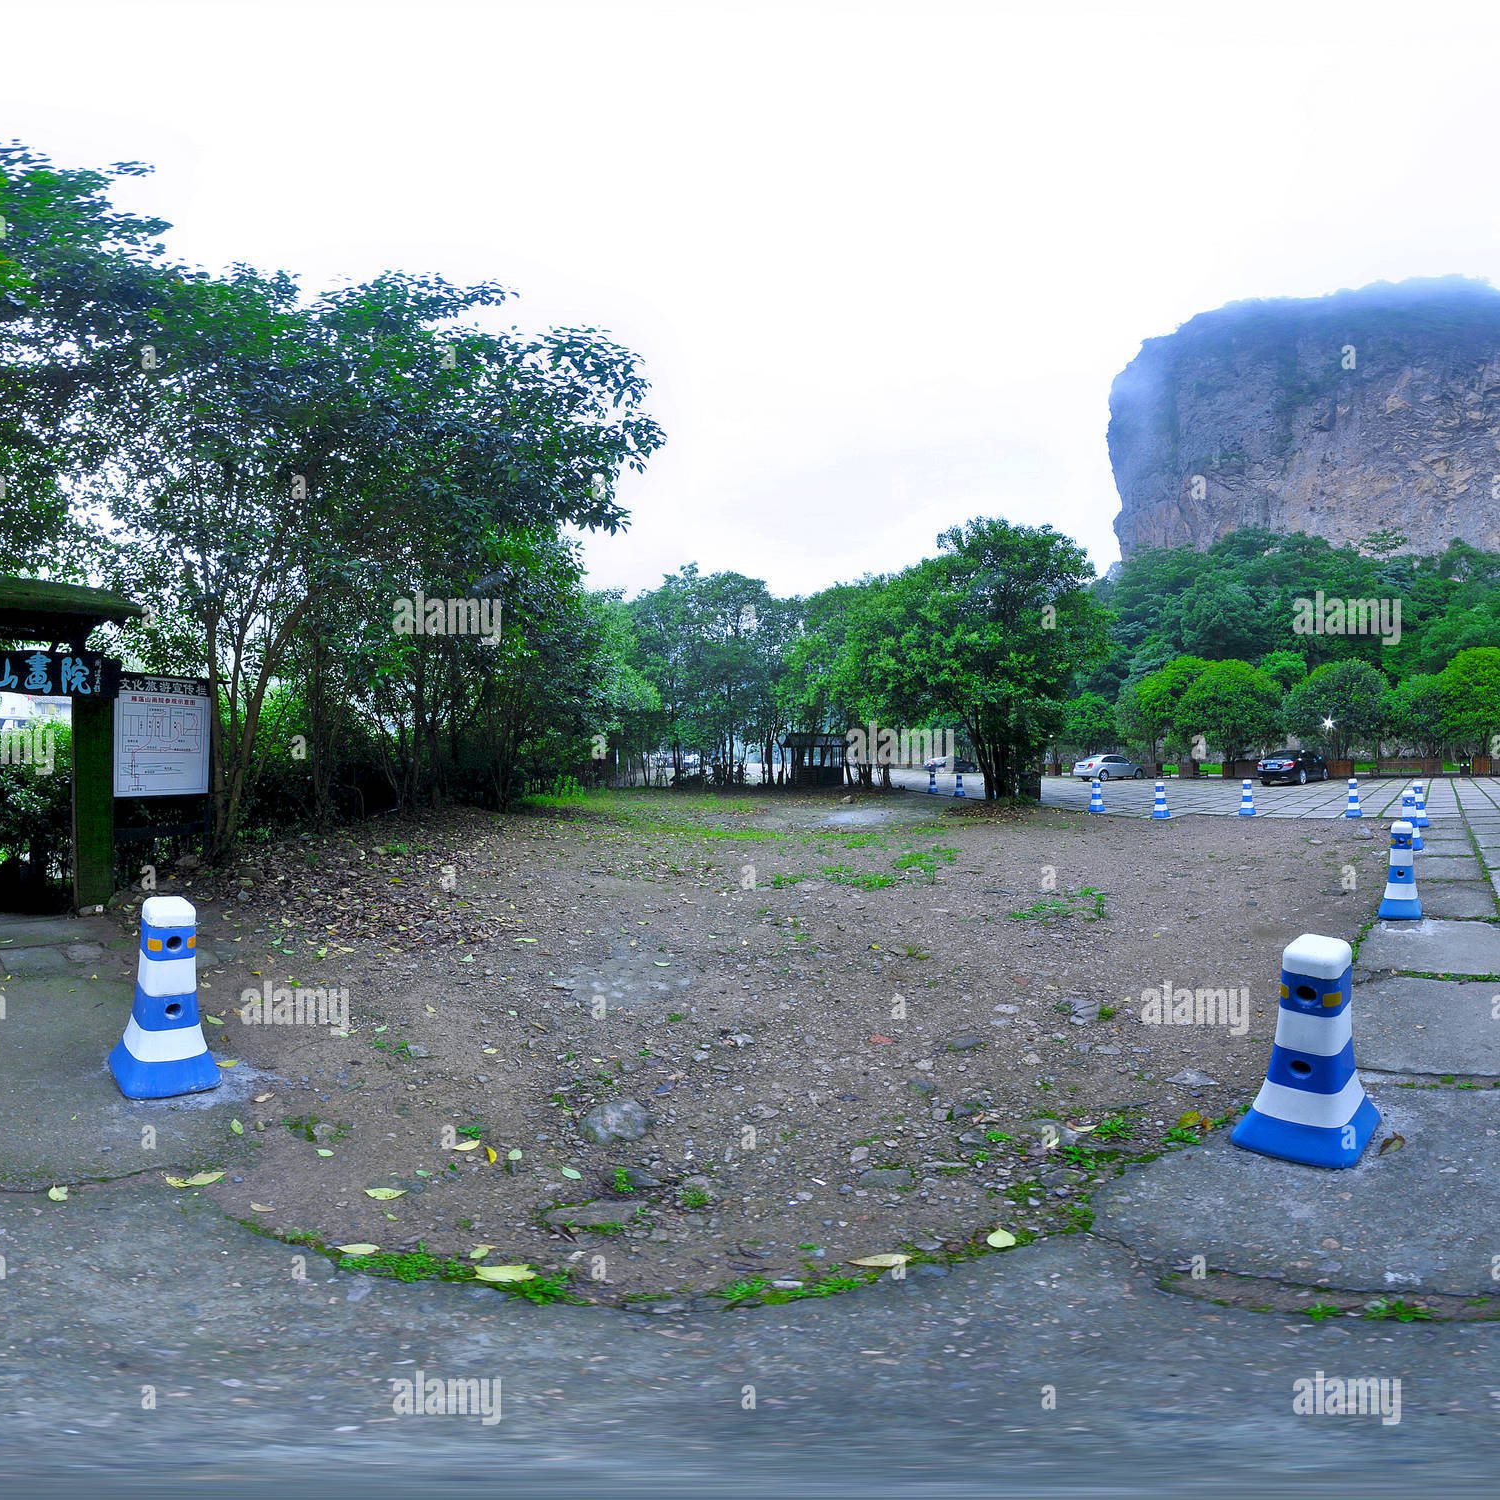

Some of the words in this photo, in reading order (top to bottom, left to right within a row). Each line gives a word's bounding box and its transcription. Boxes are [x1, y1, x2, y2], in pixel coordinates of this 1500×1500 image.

[119, 677, 208, 696] 文化旅游宣传栏
